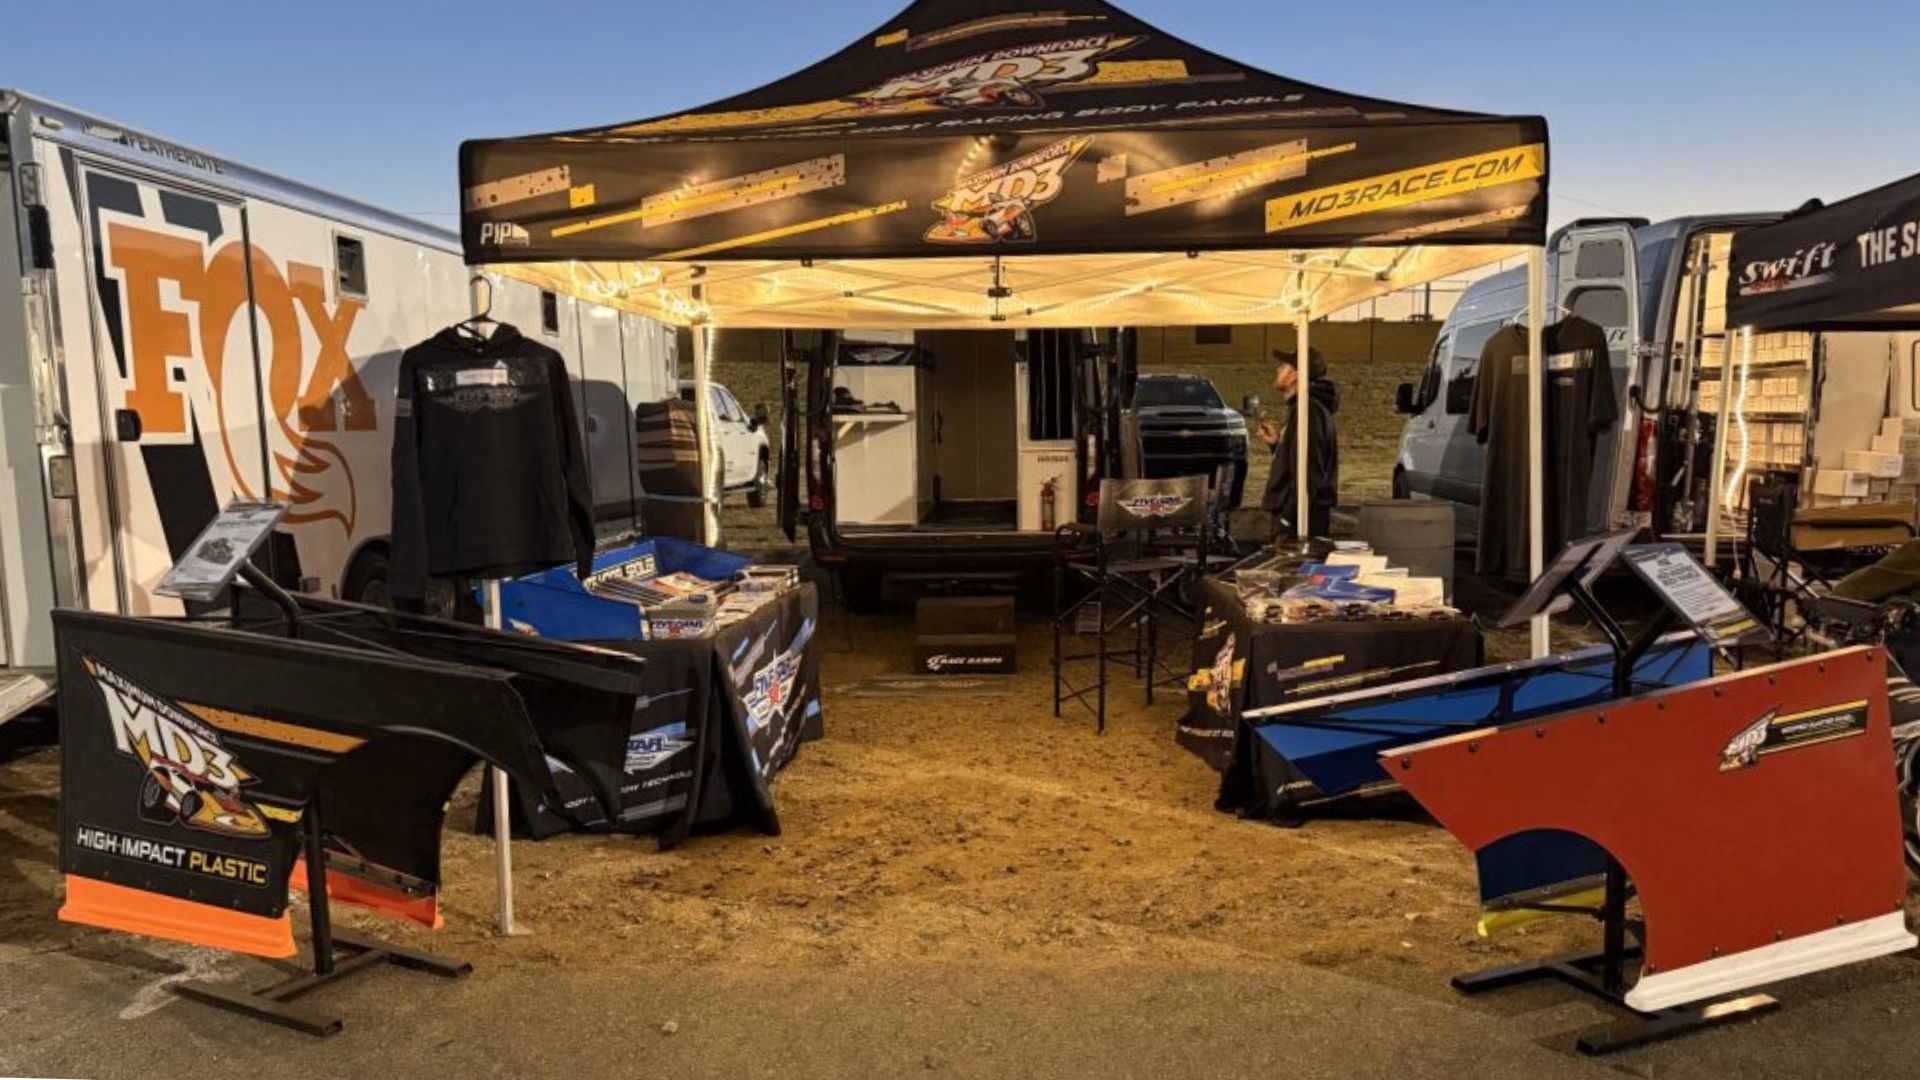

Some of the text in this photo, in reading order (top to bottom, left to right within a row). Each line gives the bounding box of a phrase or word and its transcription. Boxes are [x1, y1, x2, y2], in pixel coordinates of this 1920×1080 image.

[936, 111, 1065, 128] RACING
[1074, 104, 1167, 117] BODY
[1175, 93, 1307, 109] PANELS
[1289, 153, 1525, 219] MD3RACE.COM
[1857, 219, 1920, 268] THE S
[108, 222, 377, 445] FOX
[98, 680, 239, 788] MD3
[76, 827, 266, 883] HIGH-IMPACT PLASTIC
